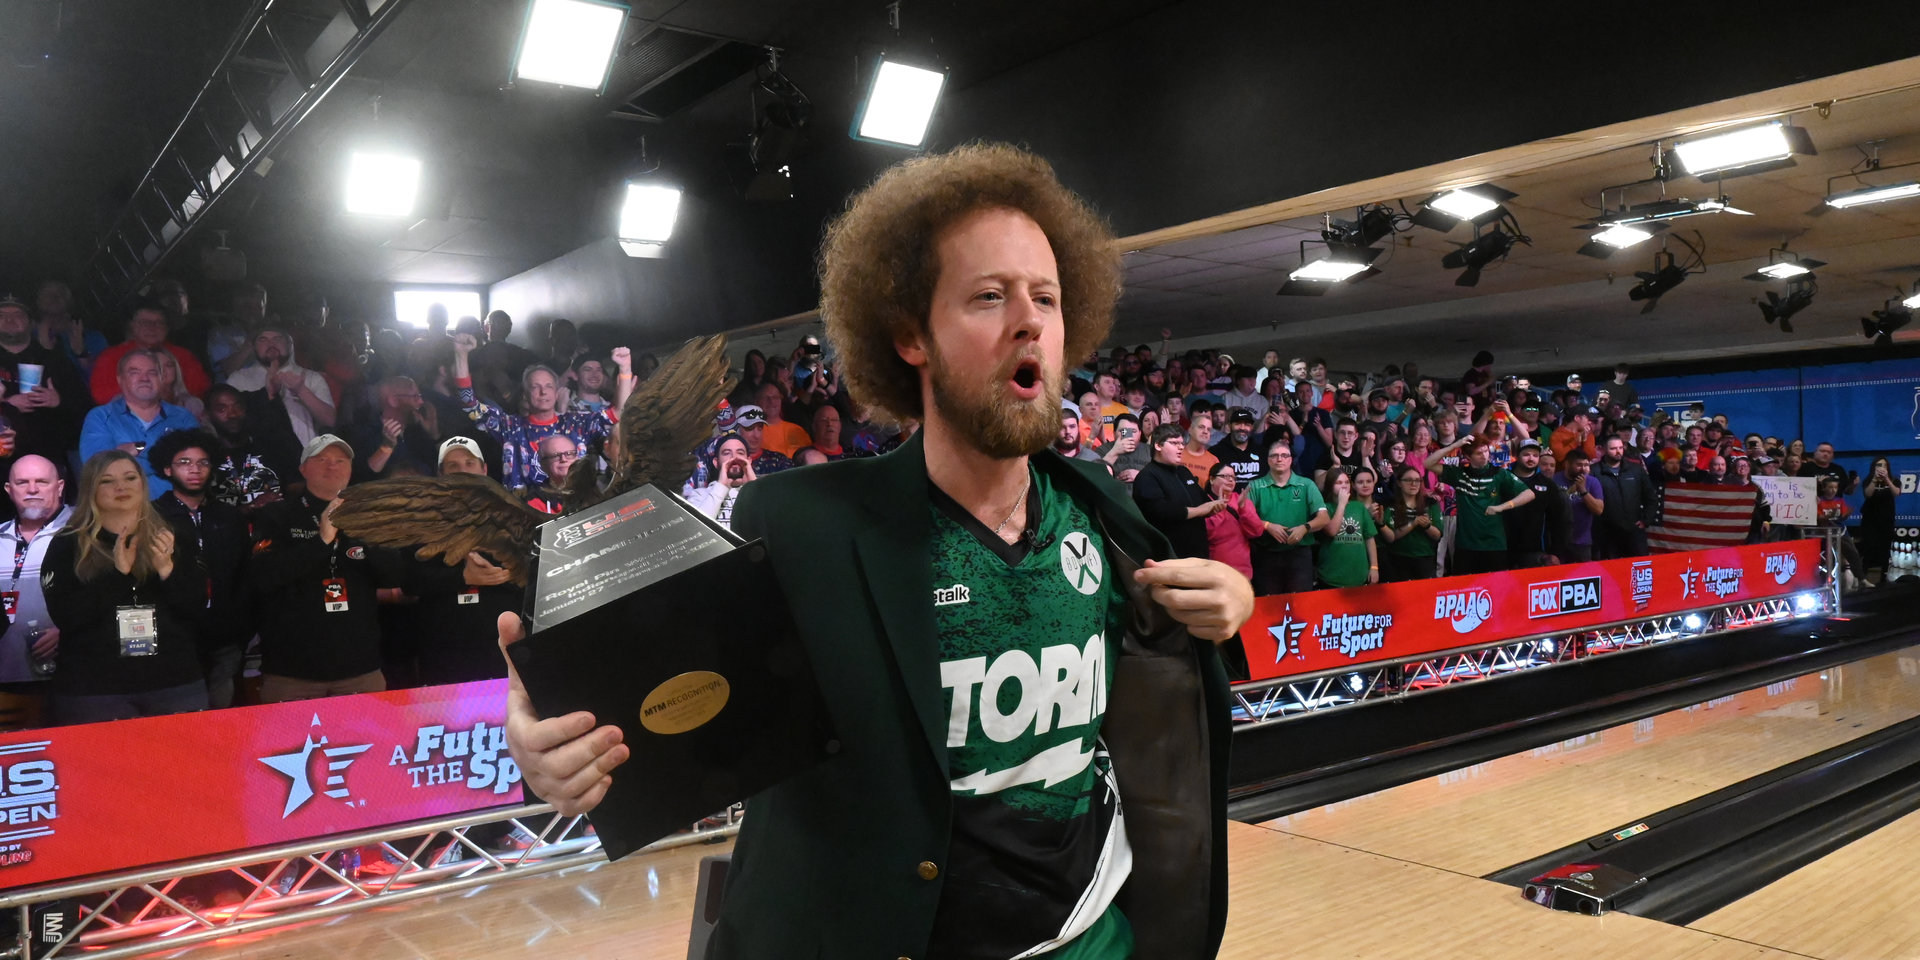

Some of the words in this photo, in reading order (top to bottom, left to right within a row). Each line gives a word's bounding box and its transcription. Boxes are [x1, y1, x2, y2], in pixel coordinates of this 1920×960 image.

[1777, 490, 1789, 499] to
[1788, 481, 1798, 491] is
[1775, 503, 1810, 520] PIC!
[1707, 566, 1734, 582] Future
[1733, 568, 1743, 578] FOR
[1765, 555, 1789, 574] BPAA
[545, 578, 588, 602] Royal
[1531, 586, 1558, 612] FOX
[1562, 582, 1598, 609] PBA
[1637, 585, 1652, 593] OPEN
[1705, 582, 1716, 593] THE
[1715, 578, 1739, 599] Sport
[539, 594, 586, 618] January
[588, 585, 605, 598] 27
[1434, 592, 1477, 620] BPAA
[1312, 624, 1321, 637] A
[1321, 613, 1374, 636] Future
[1374, 614, 1392, 629] FOR
[1319, 636, 1339, 651] THE
[1340, 628, 1384, 658] Sport
[644, 702, 667, 717] MTM
[389, 744, 409, 766] A
[414, 722, 509, 763] Futu
[407, 761, 464, 788] THE
[9, 843, 21, 851] BY
